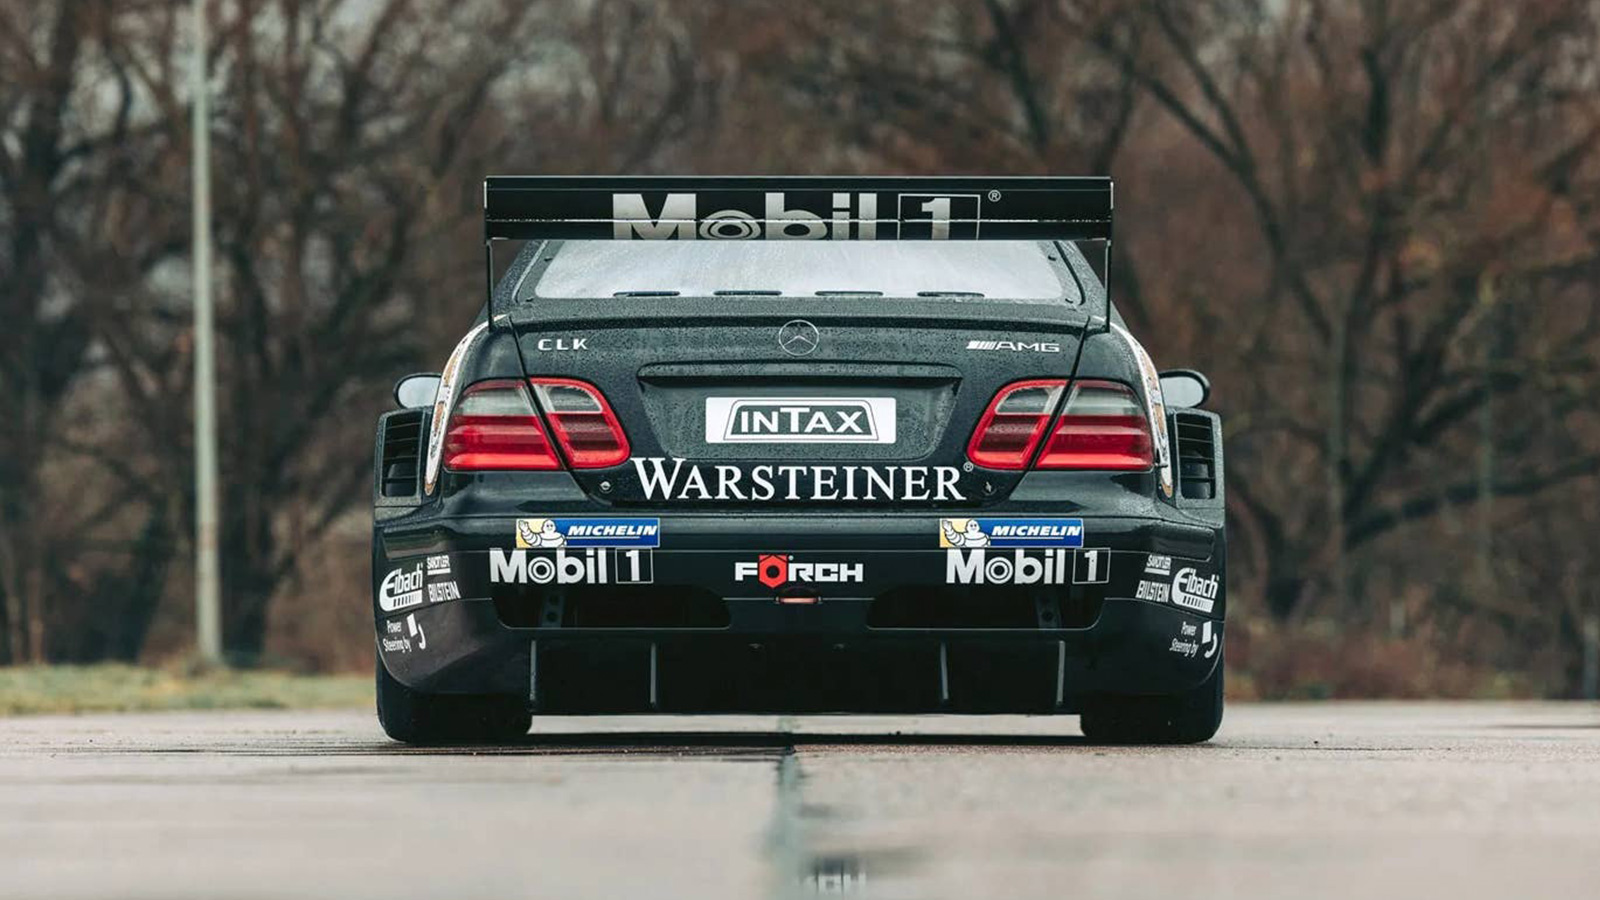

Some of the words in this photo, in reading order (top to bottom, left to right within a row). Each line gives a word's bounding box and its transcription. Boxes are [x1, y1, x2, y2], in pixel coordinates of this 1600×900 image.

[612, 193, 877, 240] Mobil
[921, 198, 951, 240] 1
[537, 338, 588, 351] CLK
[995, 341, 1060, 352] AMG
[740, 407, 864, 433] INTAX
[631, 457, 967, 501] WARSTEINER
[567, 525, 658, 536] MICHELIN
[991, 526, 1081, 537] MICHELIN
[489, 549, 608, 584] Mobil
[626, 550, 640, 581] 1
[946, 549, 1065, 584] Mobil
[1085, 550, 1097, 582] 1
[379, 563, 423, 611] Eibach
[428, 581, 461, 602] BILSTEIN
[1135, 580, 1171, 602] BILSTEIN
[1171, 567, 1219, 612] Eibach
